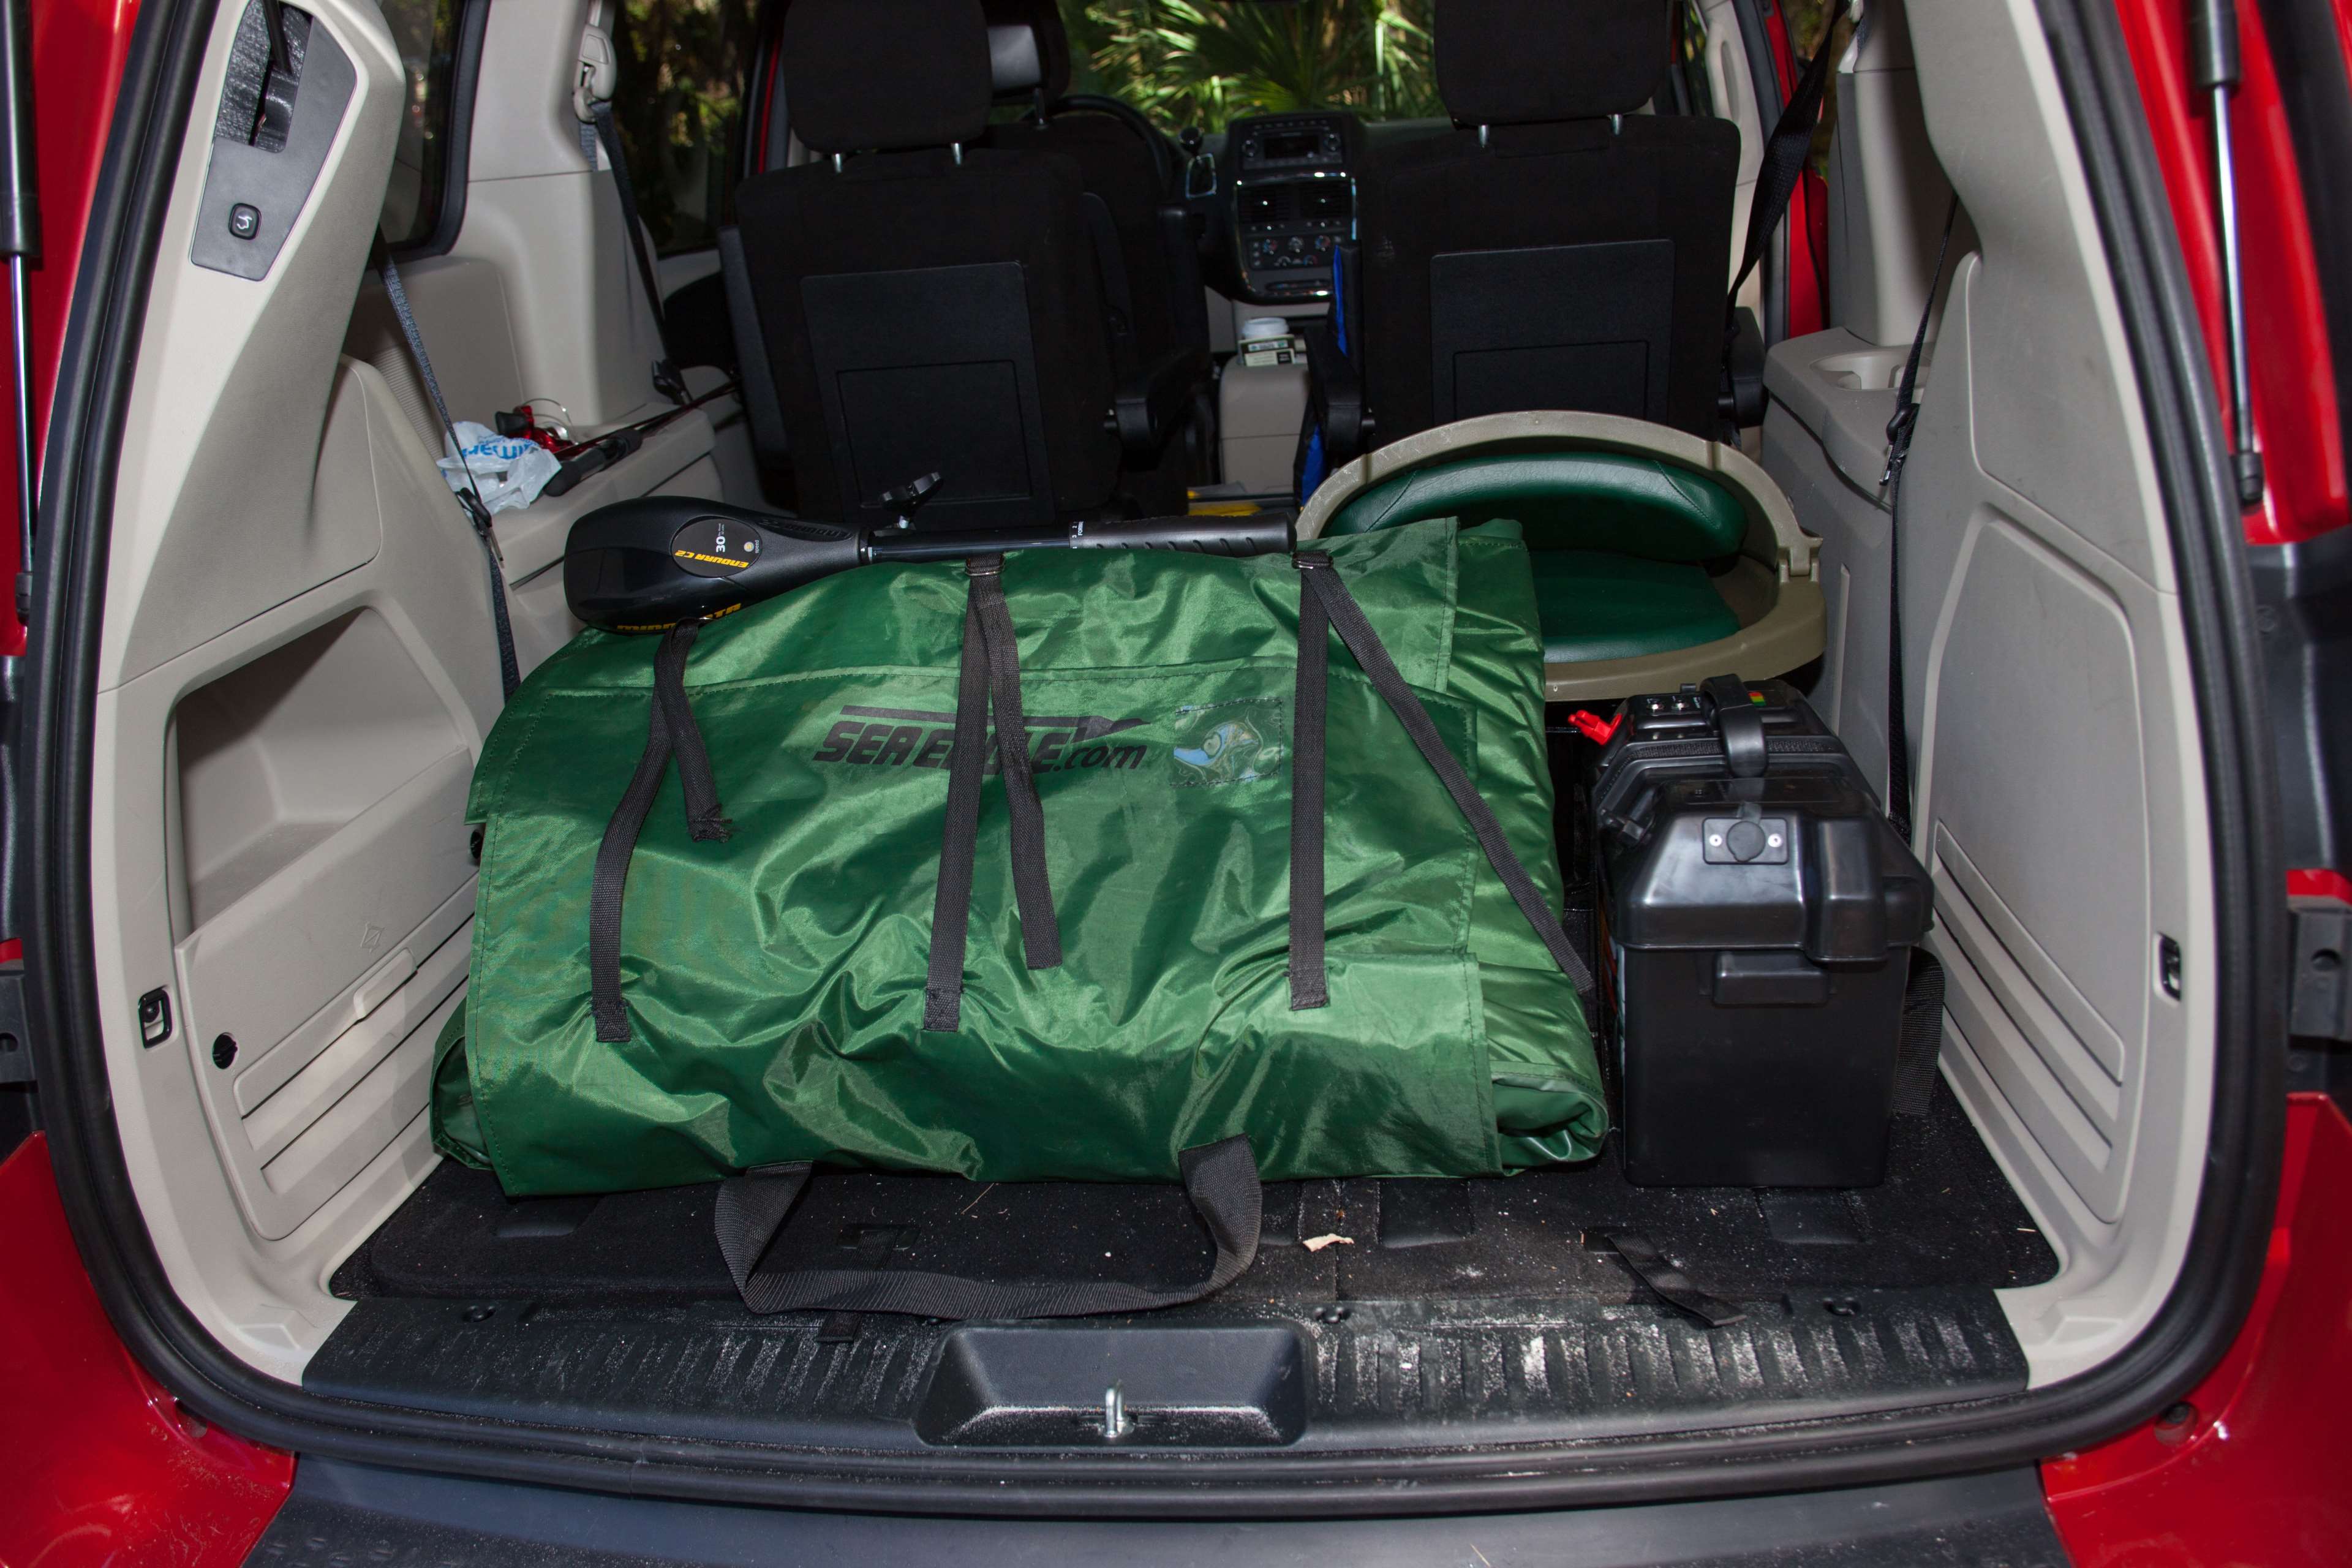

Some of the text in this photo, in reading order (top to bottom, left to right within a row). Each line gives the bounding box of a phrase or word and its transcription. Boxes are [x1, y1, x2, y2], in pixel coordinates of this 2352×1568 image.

[461, 443, 532, 459] lmart
[715, 535, 726, 553] 30
[674, 549, 695, 559] C2
[813, 720, 1148, 775] SEA EE.com
